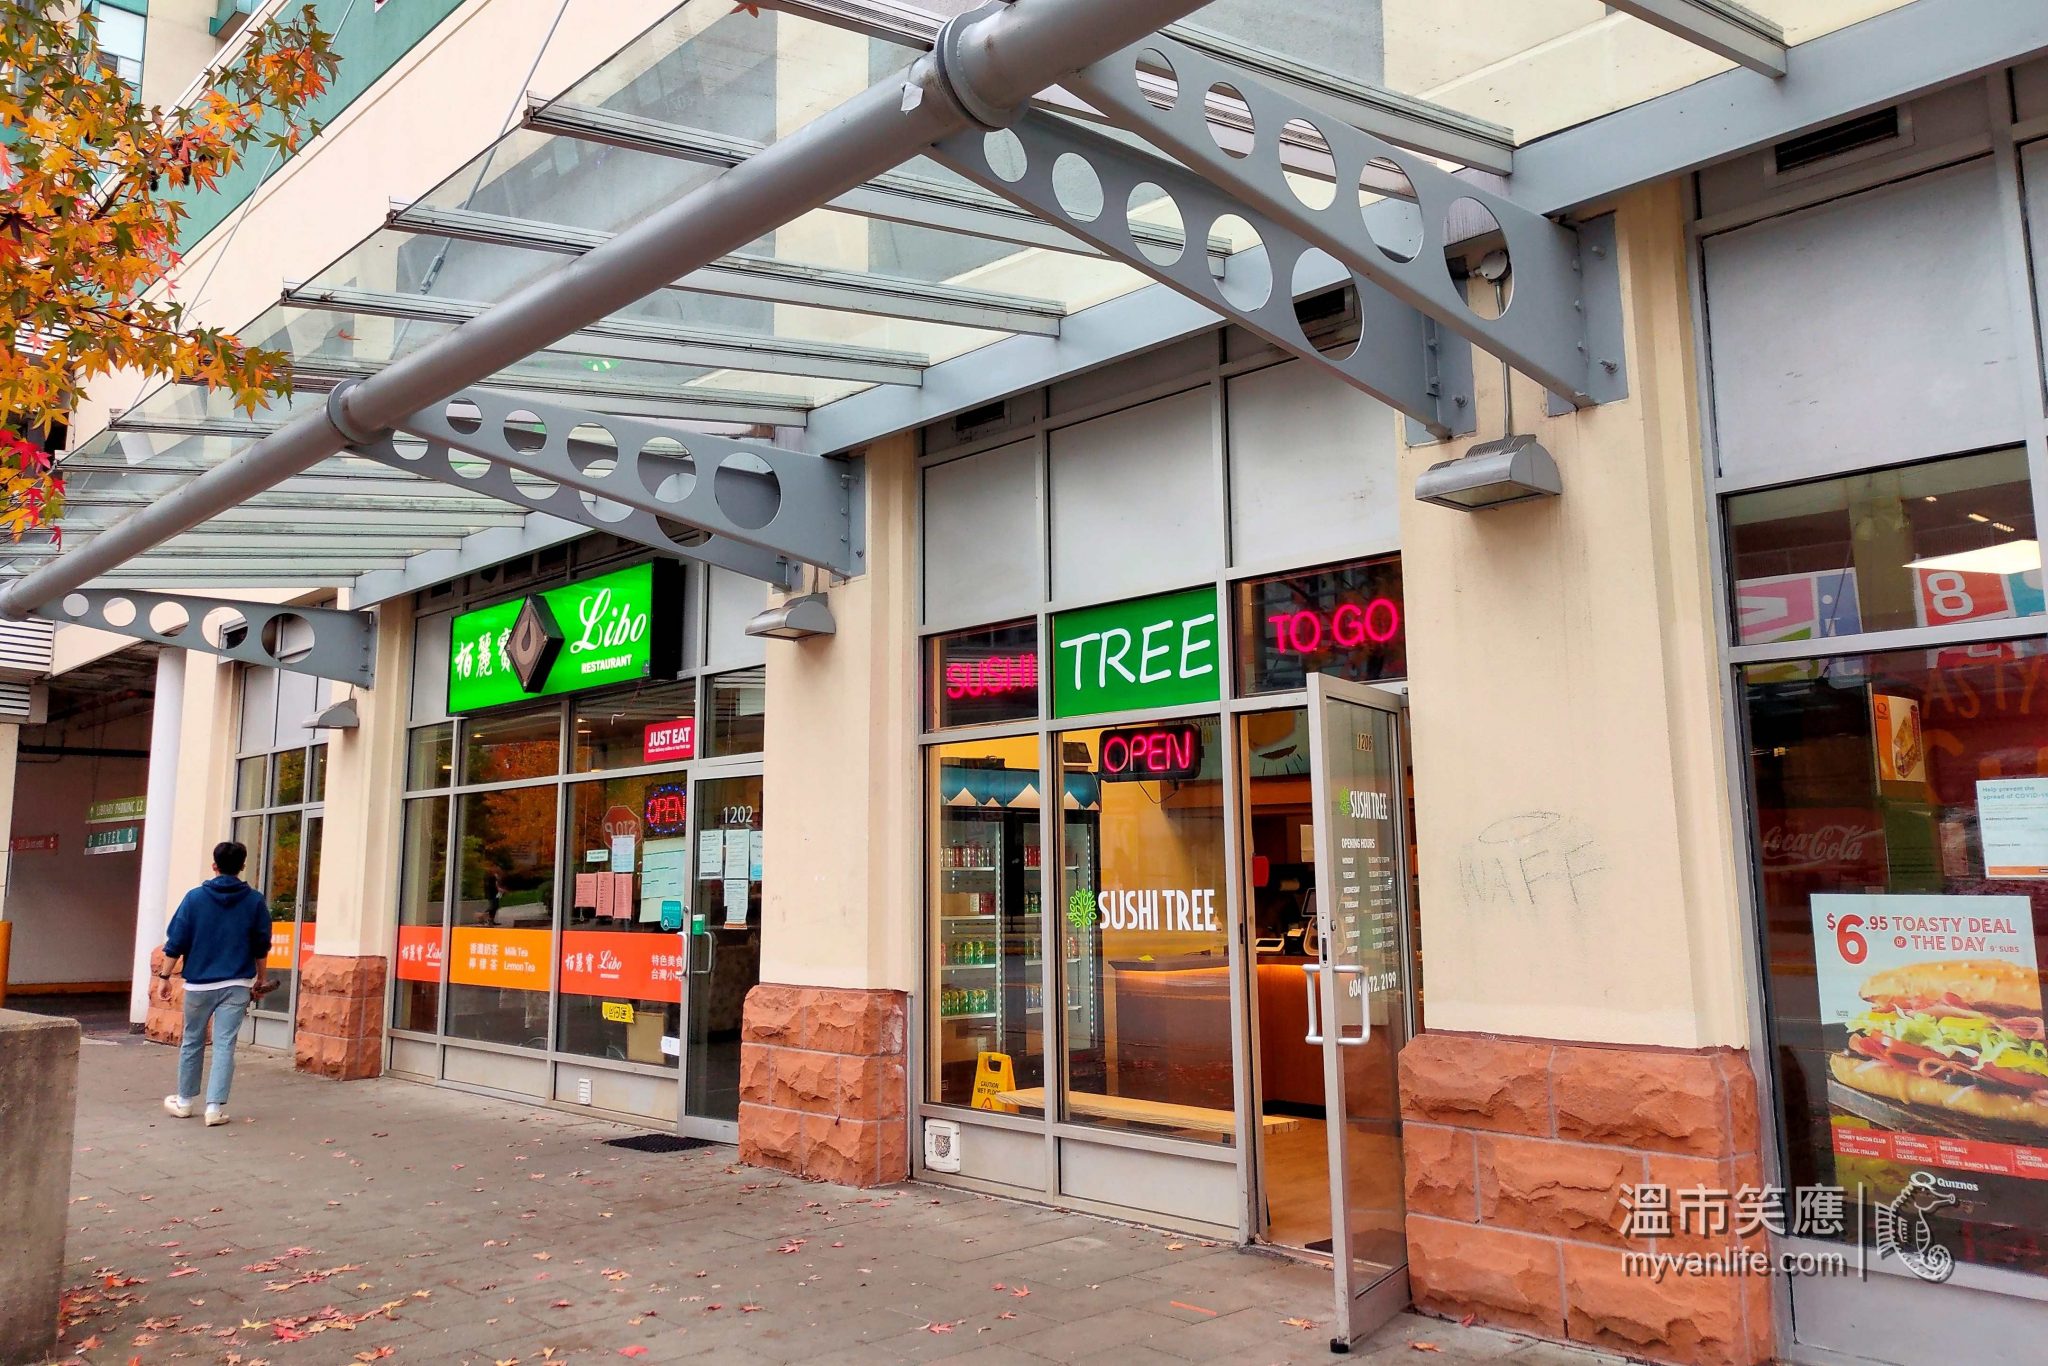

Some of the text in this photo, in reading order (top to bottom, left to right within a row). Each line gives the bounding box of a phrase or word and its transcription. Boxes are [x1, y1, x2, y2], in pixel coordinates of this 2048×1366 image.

[570, 588, 647, 654] Libo
[1269, 598, 1398, 654] TO GO
[1060, 613, 1215, 690] TREE
[581, 653, 633, 674] RESTAURANT
[946, 652, 1037, 699] SUSHI
[648, 726, 691, 747] JUST EAT
[1358, 733, 1372, 751] 1206
[1103, 730, 1191, 775] OPEN
[648, 795, 686, 823] OPEN
[723, 805, 753, 824] 1202
[1350, 790, 1388, 820] SUSHI TREE
[1341, 838, 1375, 849] OPENING HOURS
[1098, 889, 1217, 931] SUSHI TREE
[1892, 916, 1962, 933] TOASTY
[1968, 917, 2017, 934] DEAL
[504, 946, 517, 957] Milk
[1911, 935, 1946, 951] THE
[1951, 936, 1986, 952] DAY
[504, 961, 525, 972] Lemon
[598, 949, 622, 971] Libo
[1380, 971, 1396, 990] 2199
[980, 1081, 999, 1089] CAUTION
[1895, 1140, 1928, 1149] TRADITIONAL
[1940, 1145, 1968, 1154] MEATBALL
[1896, 1153, 1933, 1163] CLASSIC CLUB
